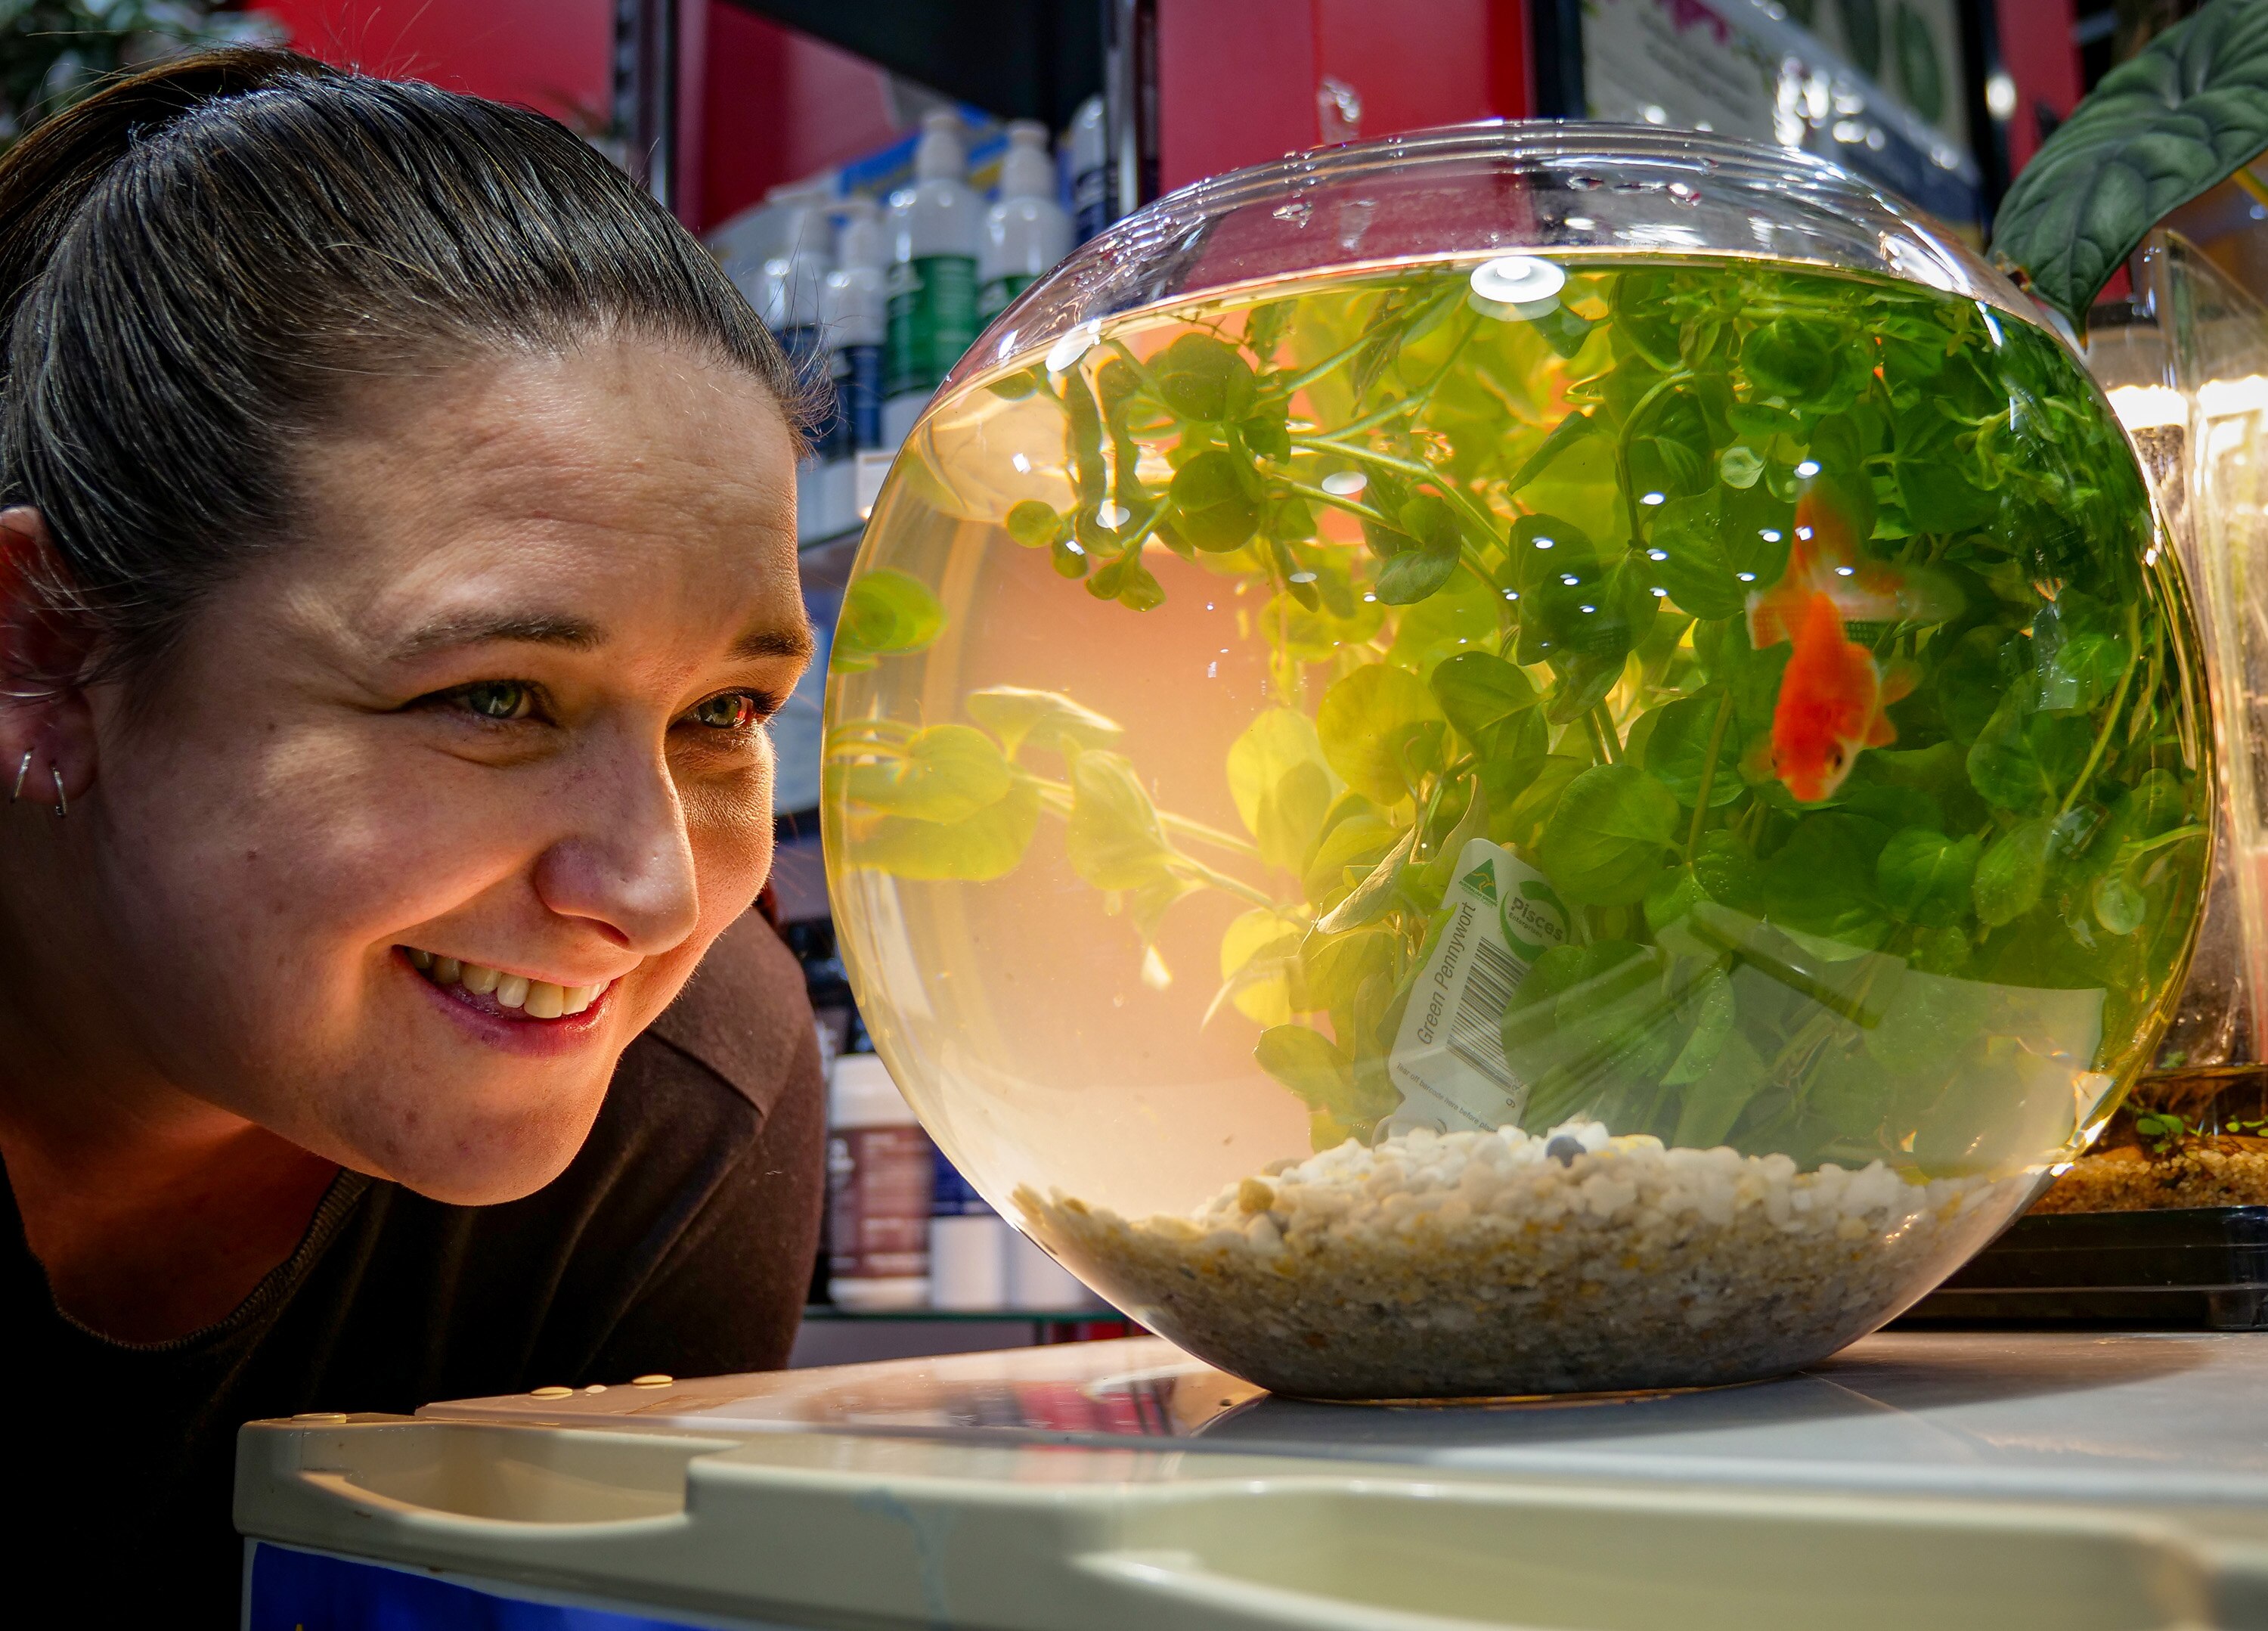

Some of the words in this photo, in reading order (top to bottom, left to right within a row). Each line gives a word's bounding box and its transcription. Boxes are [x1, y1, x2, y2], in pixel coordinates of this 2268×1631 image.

[1508, 912, 1543, 938] Enterprises
[1511, 897, 1563, 941] Pisces
[1417, 991, 1445, 1044] Green
[1433, 901, 1476, 991] Pennywort
[1396, 1062, 1410, 1075] Tear
[1410, 1074, 1421, 1083] off
[1419, 1080, 1444, 1100] barcode
[1444, 1097, 1458, 1110] here
[1458, 1107, 1479, 1124] before
